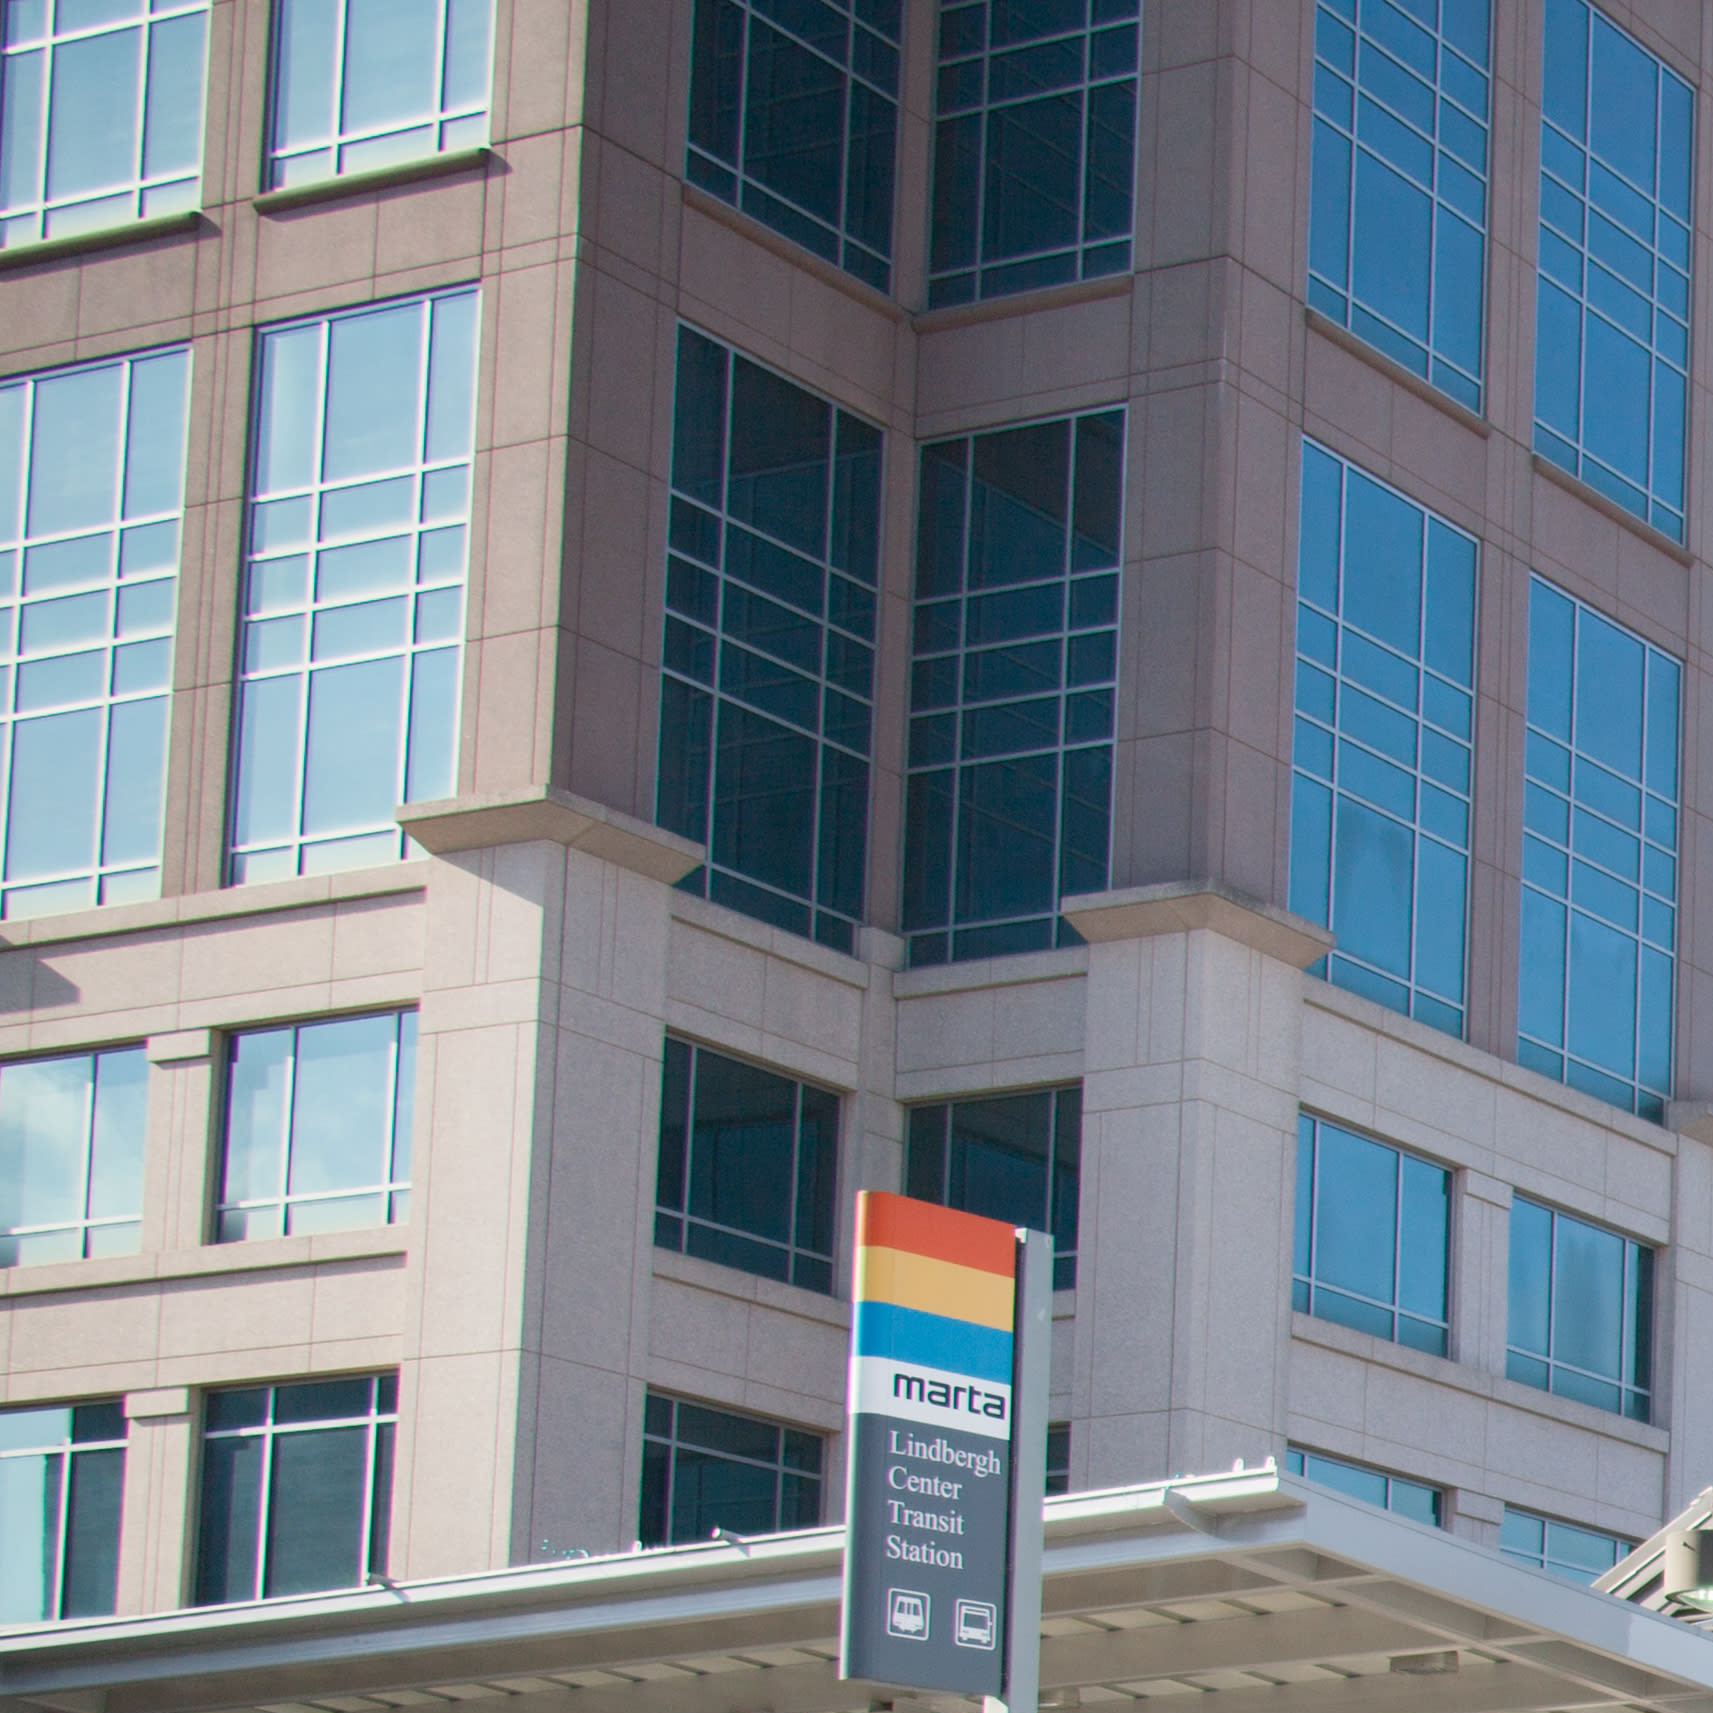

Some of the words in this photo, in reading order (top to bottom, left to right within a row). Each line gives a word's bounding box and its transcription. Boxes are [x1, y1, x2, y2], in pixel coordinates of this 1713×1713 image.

[894, 1373, 1005, 1420] marta
[890, 1430, 1001, 1477] Lindbergh
[888, 1465, 963, 1499] Center
[887, 1500, 965, 1535] Transit
[886, 1534, 964, 1570] Station
